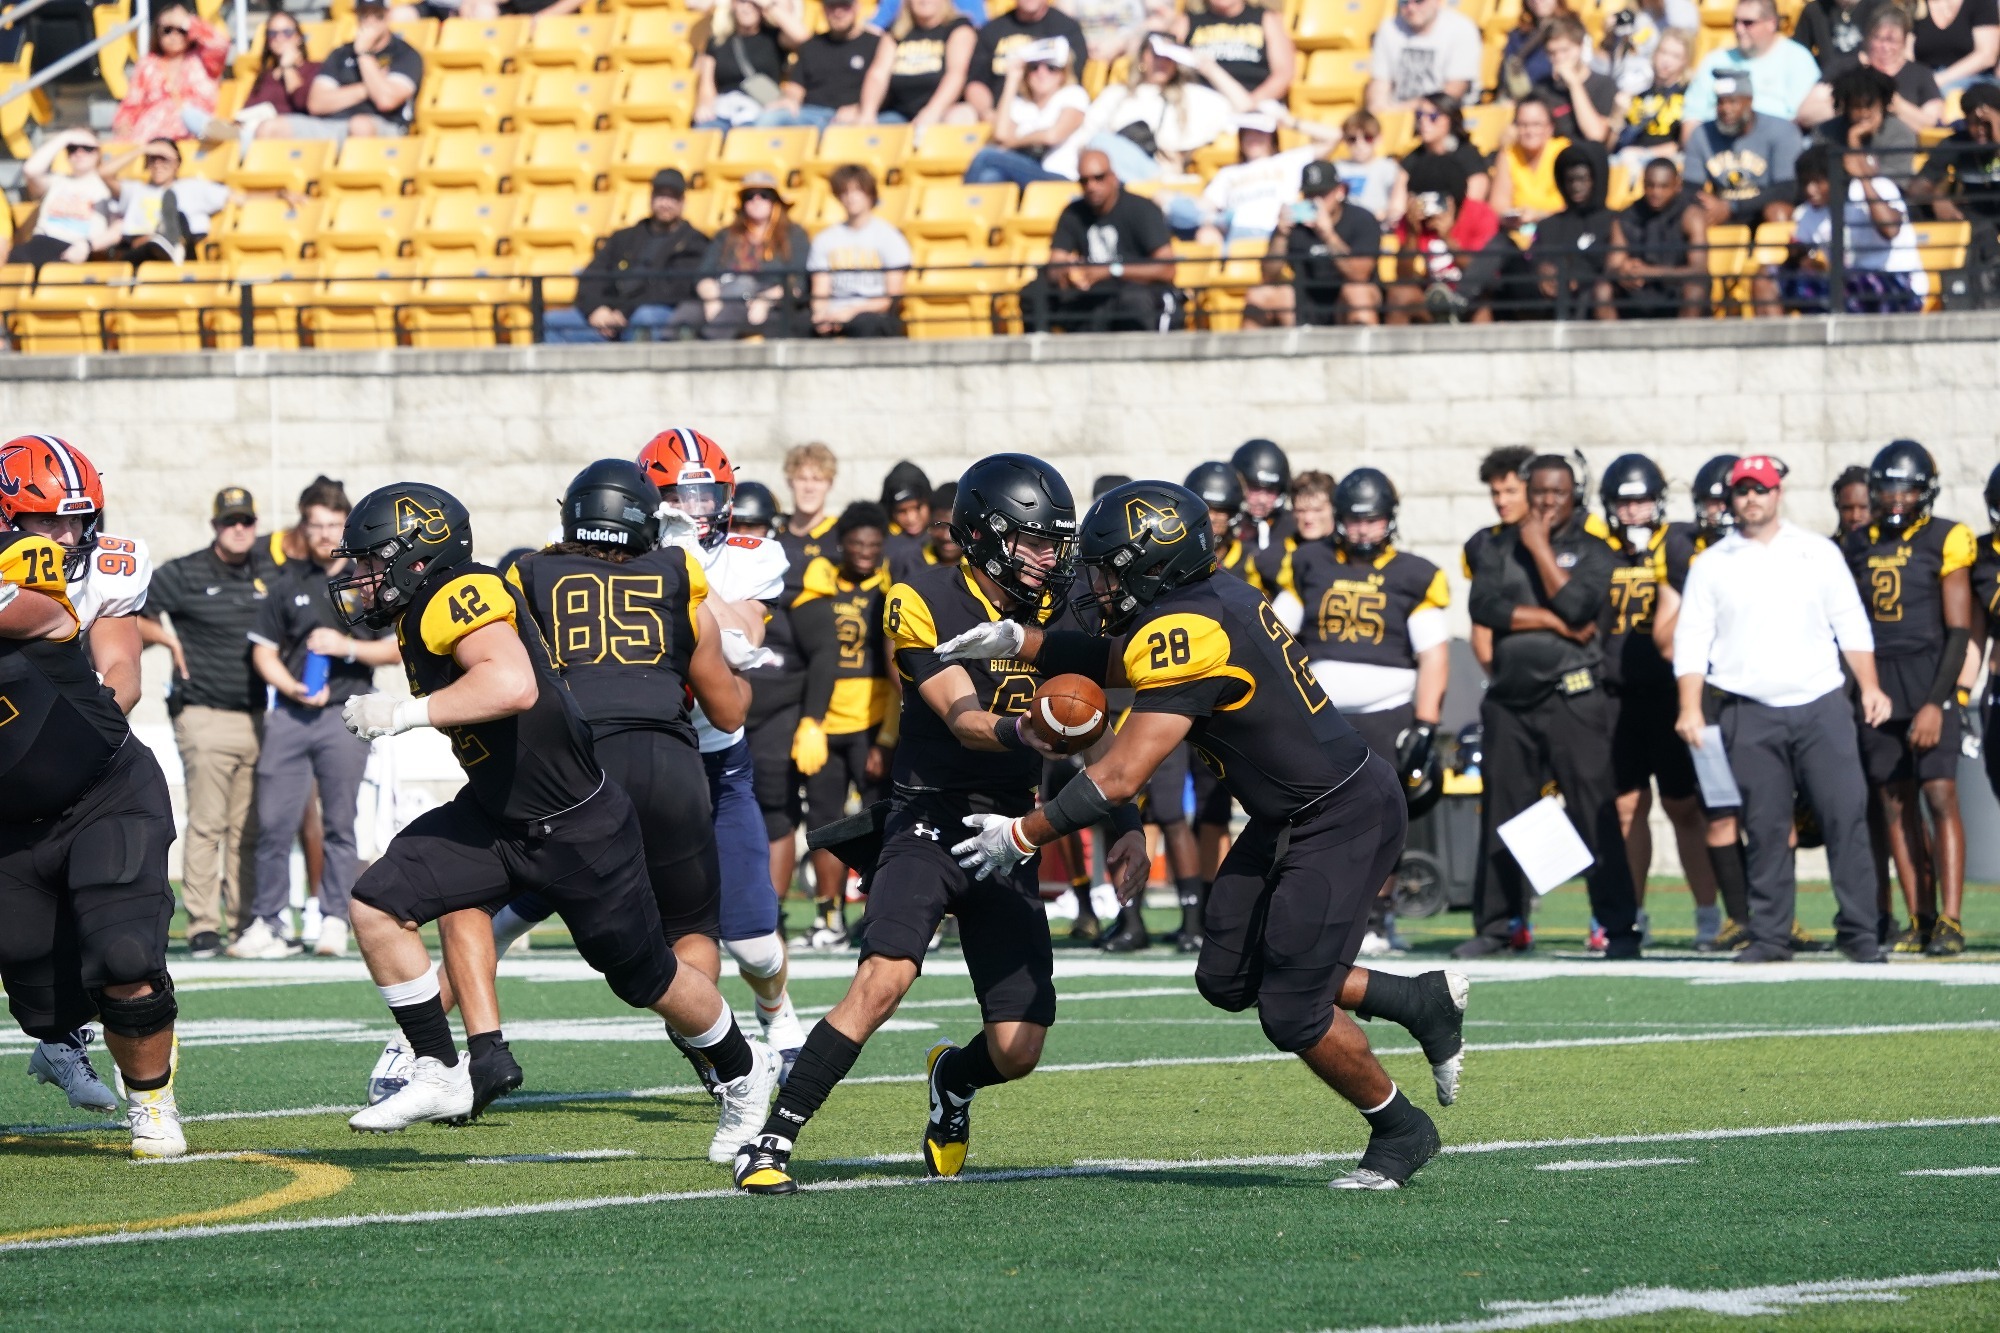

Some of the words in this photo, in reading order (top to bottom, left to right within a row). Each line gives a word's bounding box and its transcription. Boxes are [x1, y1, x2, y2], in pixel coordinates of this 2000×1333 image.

[69, 502, 87, 510] HOPE
[395, 496, 450, 544] AC
[1125, 498, 1186, 544] AC
[97, 536, 136, 577] 99
[576, 528, 628, 544] Riddell
[22, 546, 59, 585] 72
[448, 584, 491, 626] 42
[1871, 566, 1903, 622] 2
[552, 573, 665, 665] 85
[888, 598, 902, 634] 6
[990, 659, 1040, 673] BULLDO
[1147, 627, 1191, 671] 28
